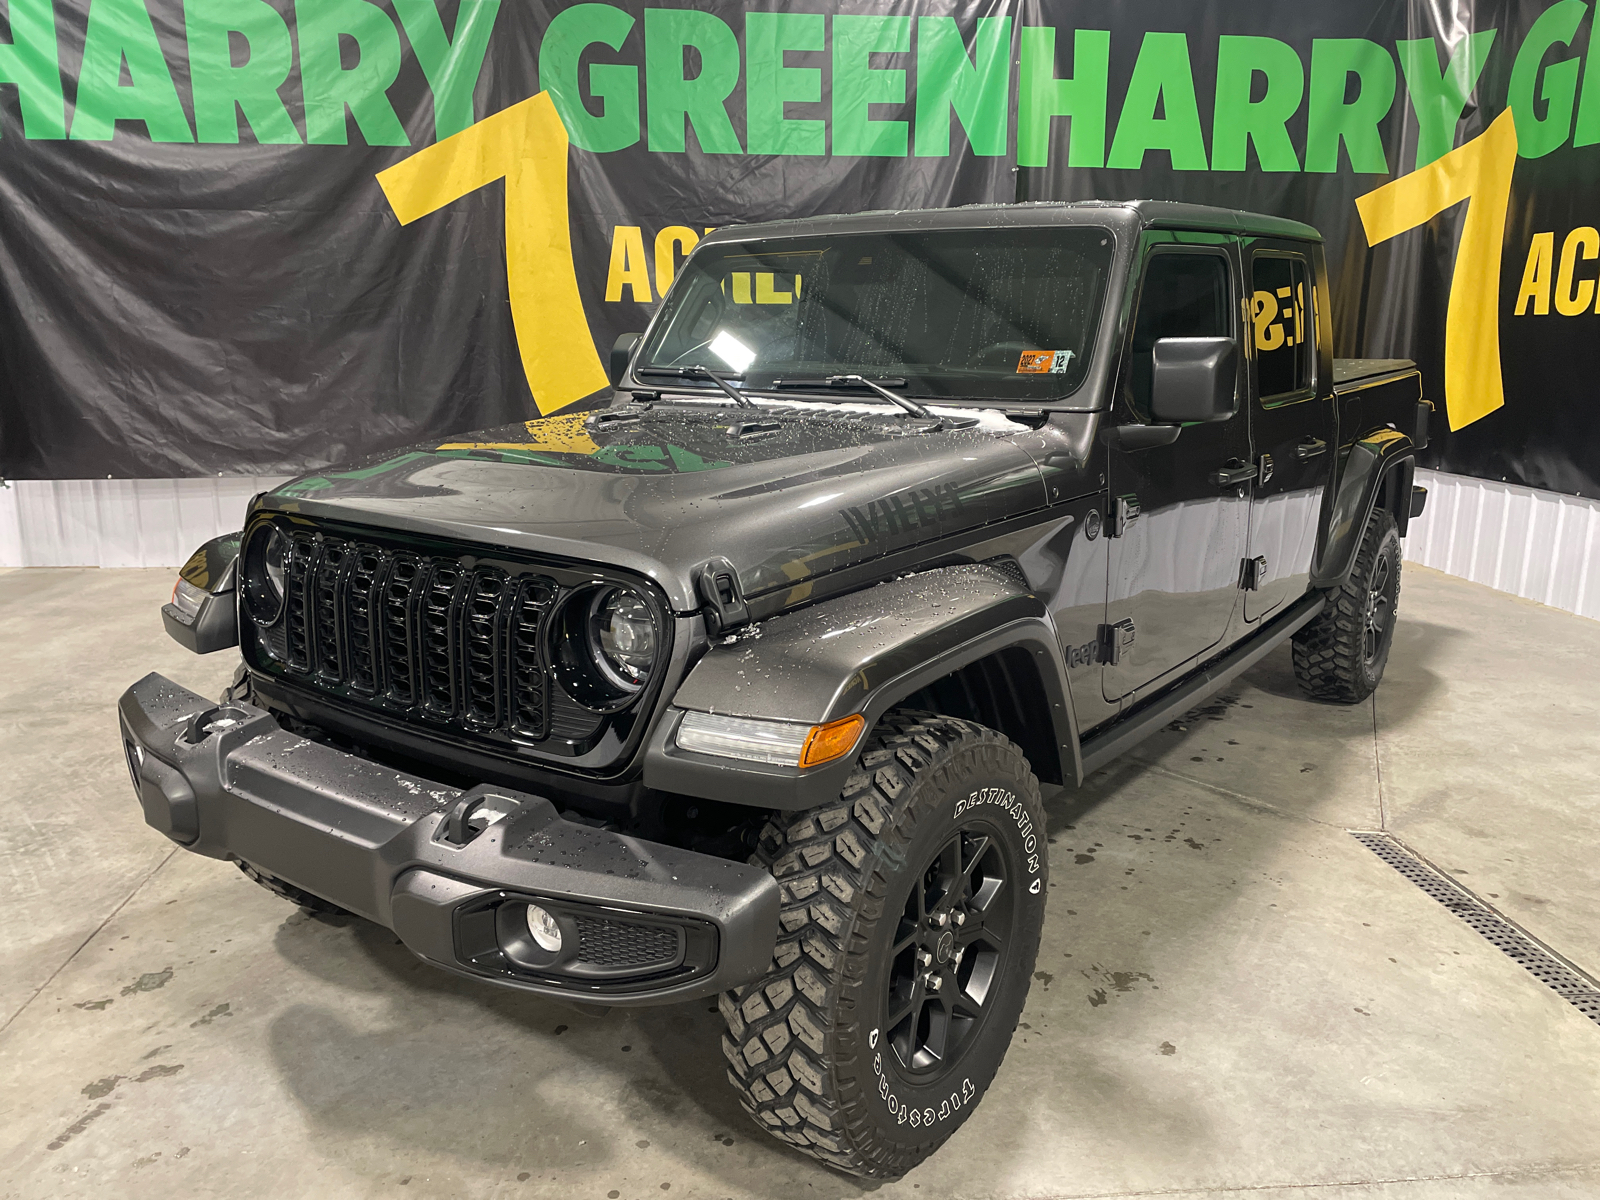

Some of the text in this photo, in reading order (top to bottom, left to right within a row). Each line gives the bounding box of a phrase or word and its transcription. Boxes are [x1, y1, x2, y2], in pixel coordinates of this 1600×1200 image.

[0, 0, 1012, 157] HARRY GREEN
[1019, 28, 1498, 174] HARRY
[375, 89, 610, 416] 7
[1355, 105, 1519, 432] 7
[1055, 355, 1066, 367] 12
[838, 481, 965, 545] WILLYS
[1065, 640, 1099, 669] Jeep
[953, 787, 1040, 874] DESTINATION
